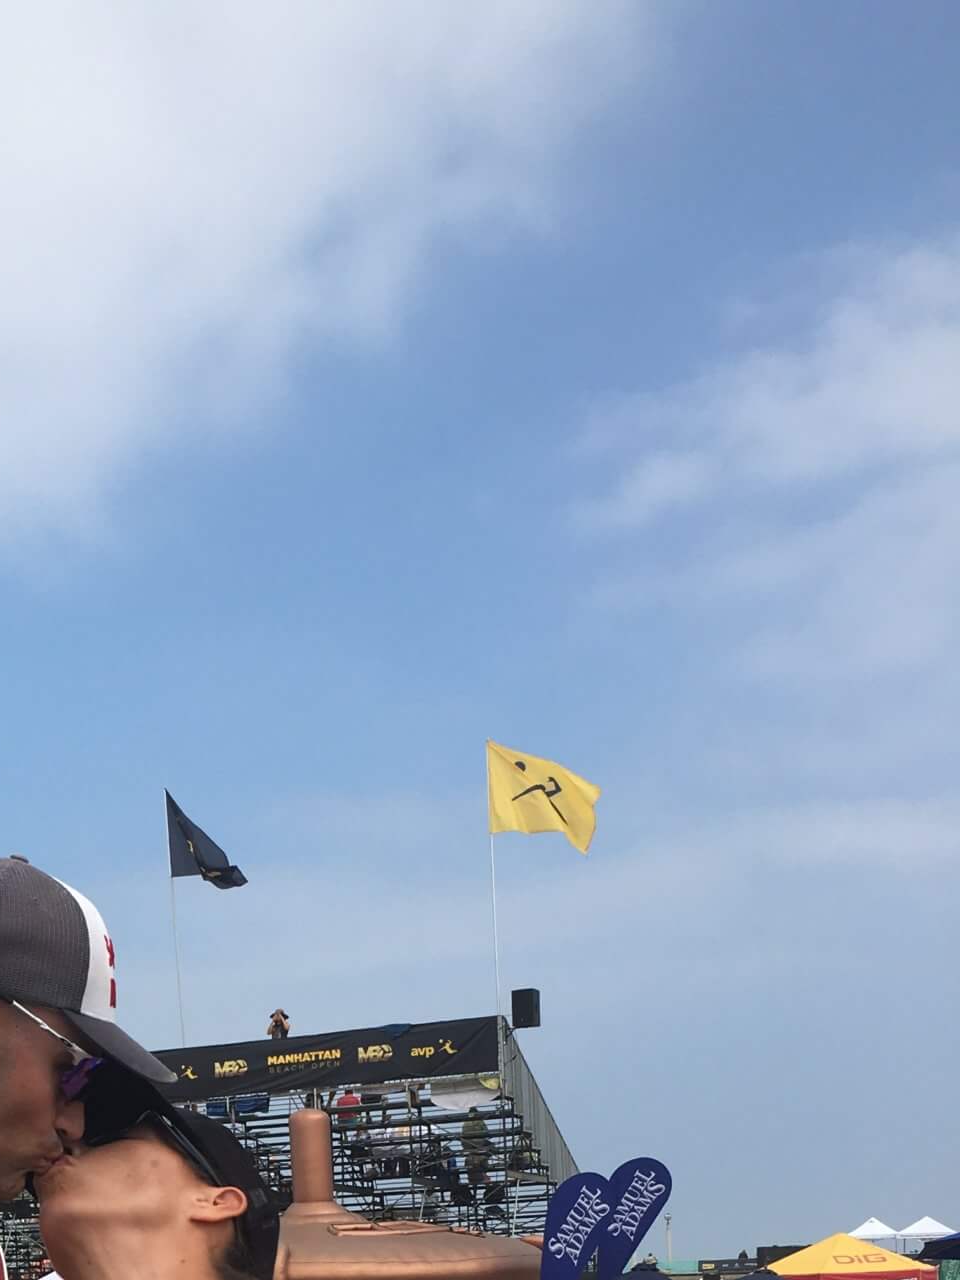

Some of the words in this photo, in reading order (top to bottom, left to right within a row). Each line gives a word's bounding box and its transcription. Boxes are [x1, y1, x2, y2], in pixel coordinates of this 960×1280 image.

[267, 1049, 341, 1066] MANHATTAN
[269, 1064, 305, 1074] BEACH
[311, 1061, 341, 1071] OPEN
[411, 1046, 434, 1058] avp
[548, 1185, 602, 1259] SAMUEL
[565, 1199, 611, 1266] ADAMS
[607, 1169, 656, 1236] SAMUEL
[621, 1180, 666, 1241] ADAMS
